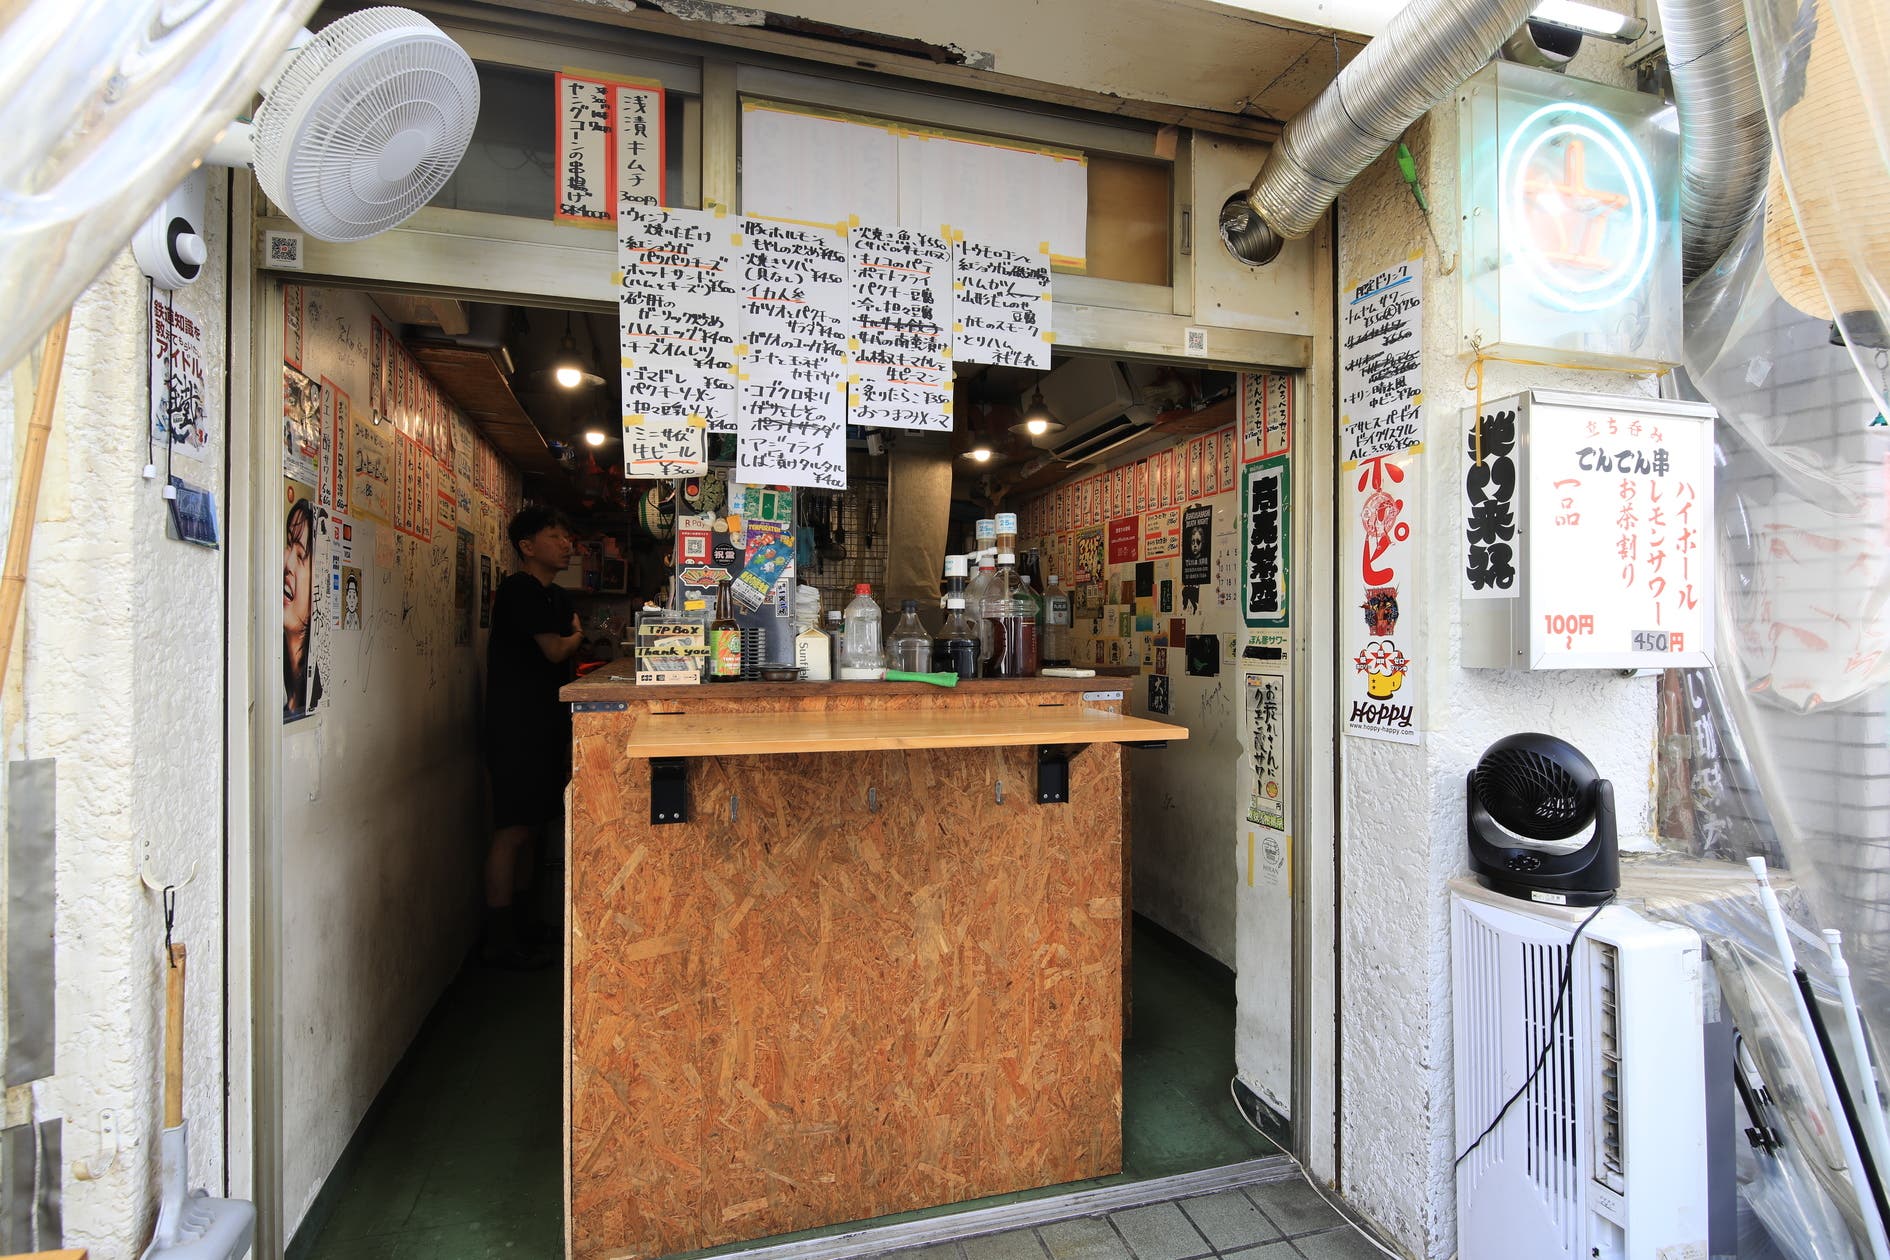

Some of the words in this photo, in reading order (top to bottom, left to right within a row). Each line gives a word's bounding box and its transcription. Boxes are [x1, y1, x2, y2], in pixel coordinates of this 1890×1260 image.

[1576, 447, 1670, 477] でんでん串
[1553, 478, 1582, 526] 一品
[1616, 478, 1639, 588] お茶割り
[1647, 479, 1667, 626] レモンサワー
[1676, 481, 1698, 610] ハイボール
[1350, 723, 1414, 735] www.hoppy-happy.com
